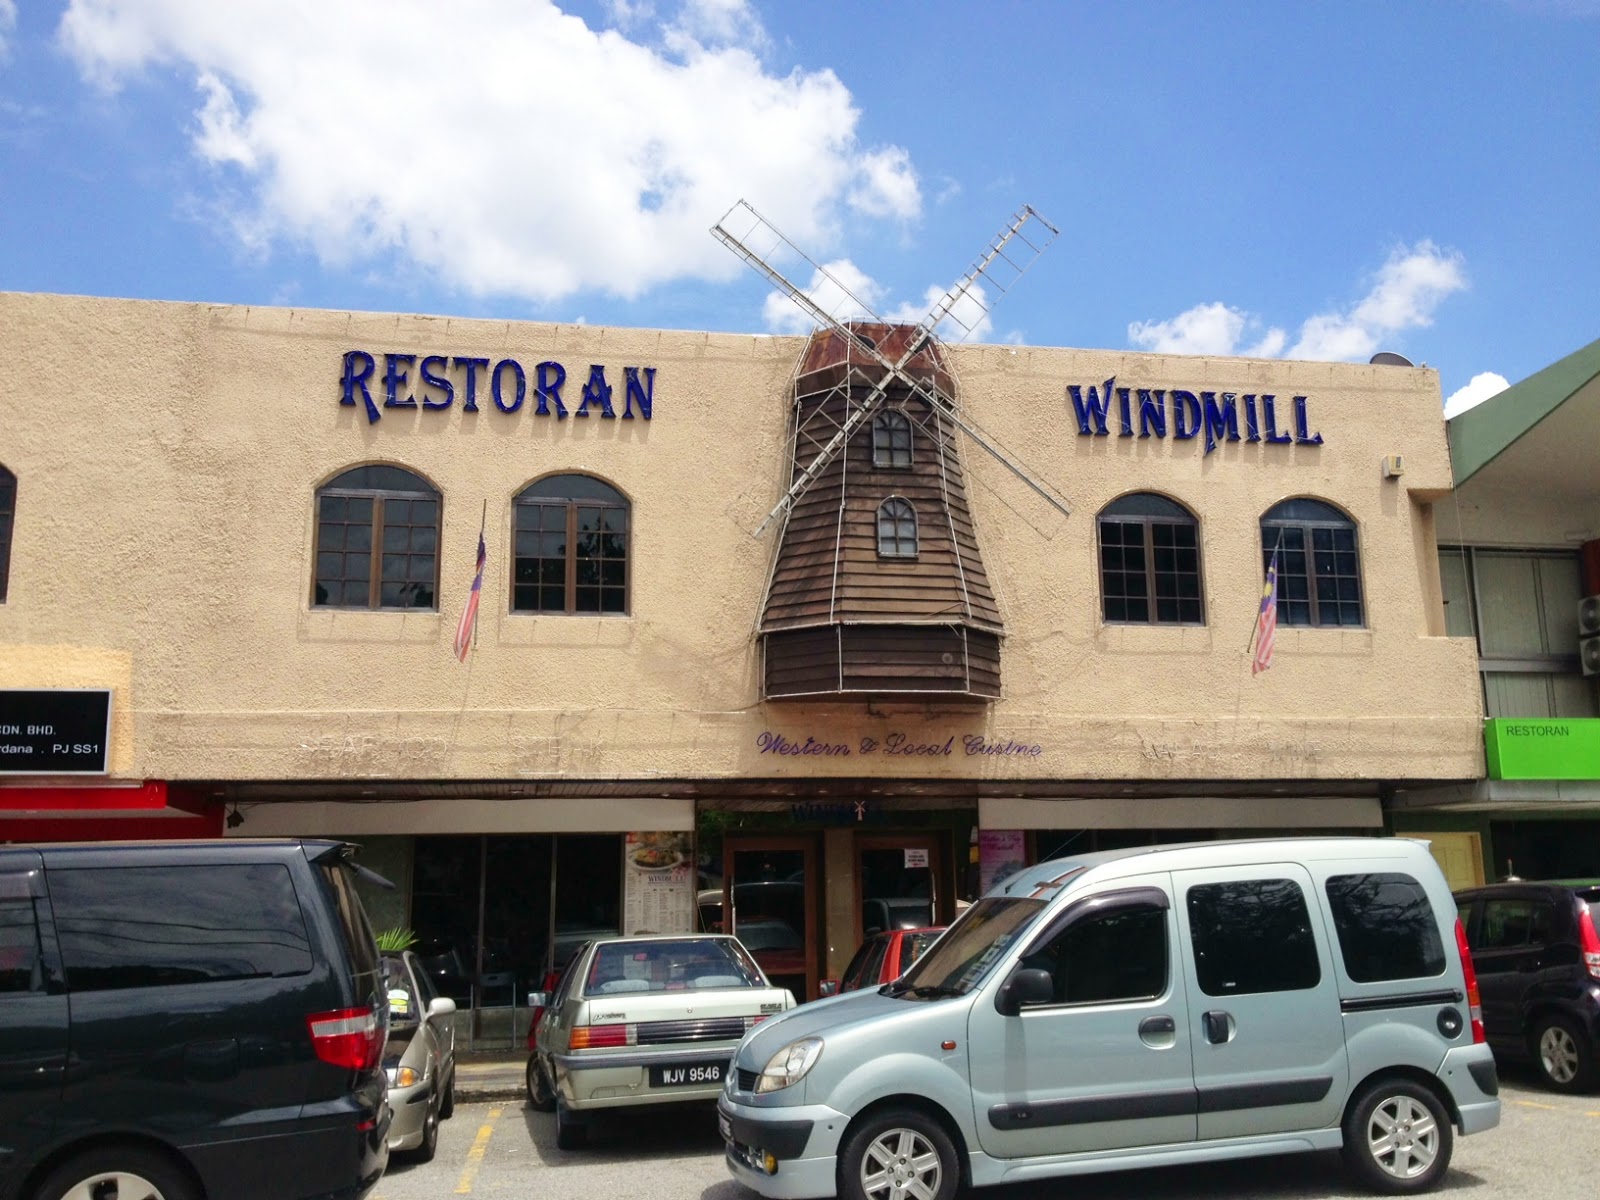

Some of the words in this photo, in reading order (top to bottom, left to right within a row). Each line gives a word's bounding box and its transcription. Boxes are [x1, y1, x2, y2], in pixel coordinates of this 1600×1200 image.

[339, 350, 657, 425] RESTORAN
[1066, 375, 1324, 457] WINDMILL
[0, 725, 23, 735] DN.
[27, 725, 57, 735] BHD.
[1506, 726, 1569, 736] RESTORAN
[53, 744, 70, 754] PJ
[73, 744, 99, 754] SS1
[757, 731, 850, 756] Western
[882, 733, 955, 755] Local
[663, 1069, 686, 1084] WJV
[689, 1067, 720, 1082] 9546
